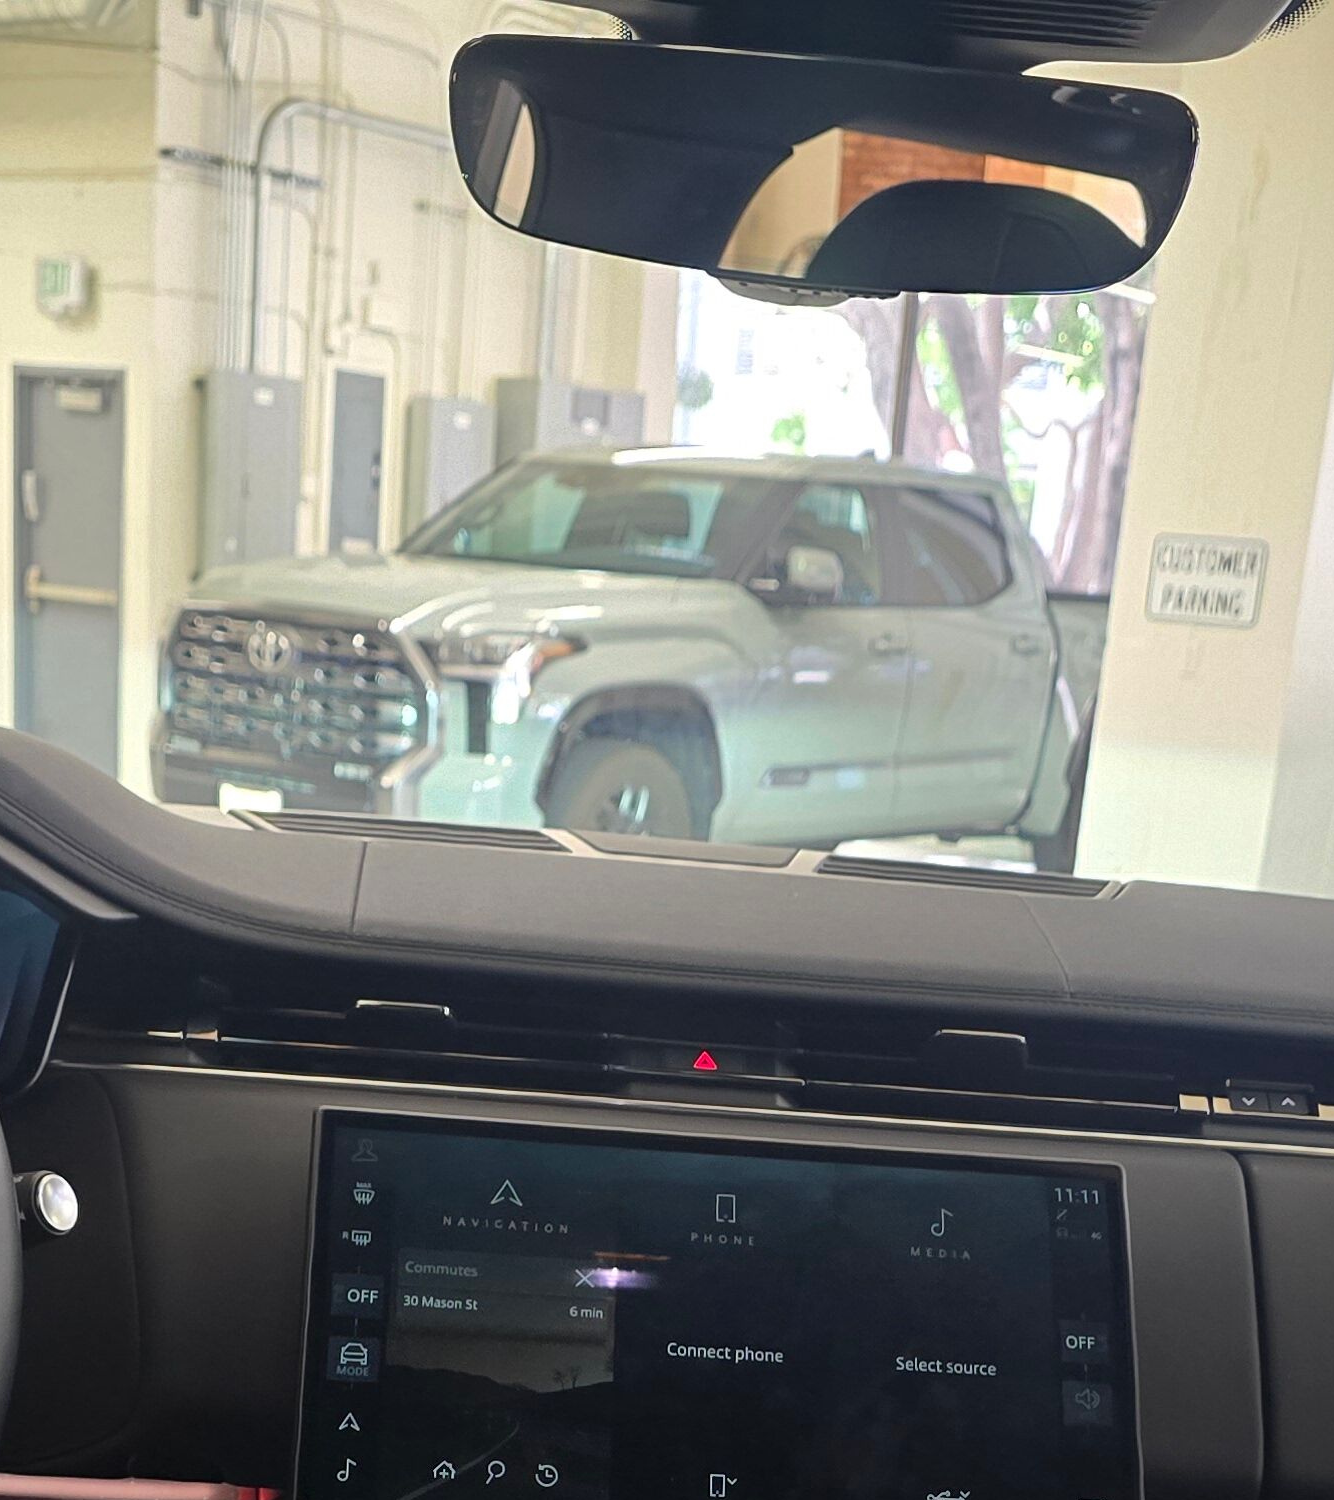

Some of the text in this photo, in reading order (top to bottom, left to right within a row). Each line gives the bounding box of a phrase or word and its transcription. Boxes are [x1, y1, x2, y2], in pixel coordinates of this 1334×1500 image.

[1156, 544, 1260, 578] CUSTOMER
[1160, 583, 1244, 617] PARKING
[1055, 1187, 1100, 1206] 11:11
[442, 1215, 569, 1235] NAVIGATION
[342, 1231, 349, 1240] R
[690, 1231, 756, 1248] PHONE
[910, 1246, 971, 1262] MEDIA
[404, 1260, 479, 1279] Commutes
[347, 1288, 379, 1304] OFF
[403, 1294, 478, 1312] 30 Mason St
[569, 1306, 604, 1320] 6 min
[1065, 1335, 1096, 1350] OFF
[667, 1342, 784, 1364] Connect phone
[335, 1365, 370, 1377] MODE
[895, 1356, 998, 1377] Select source
